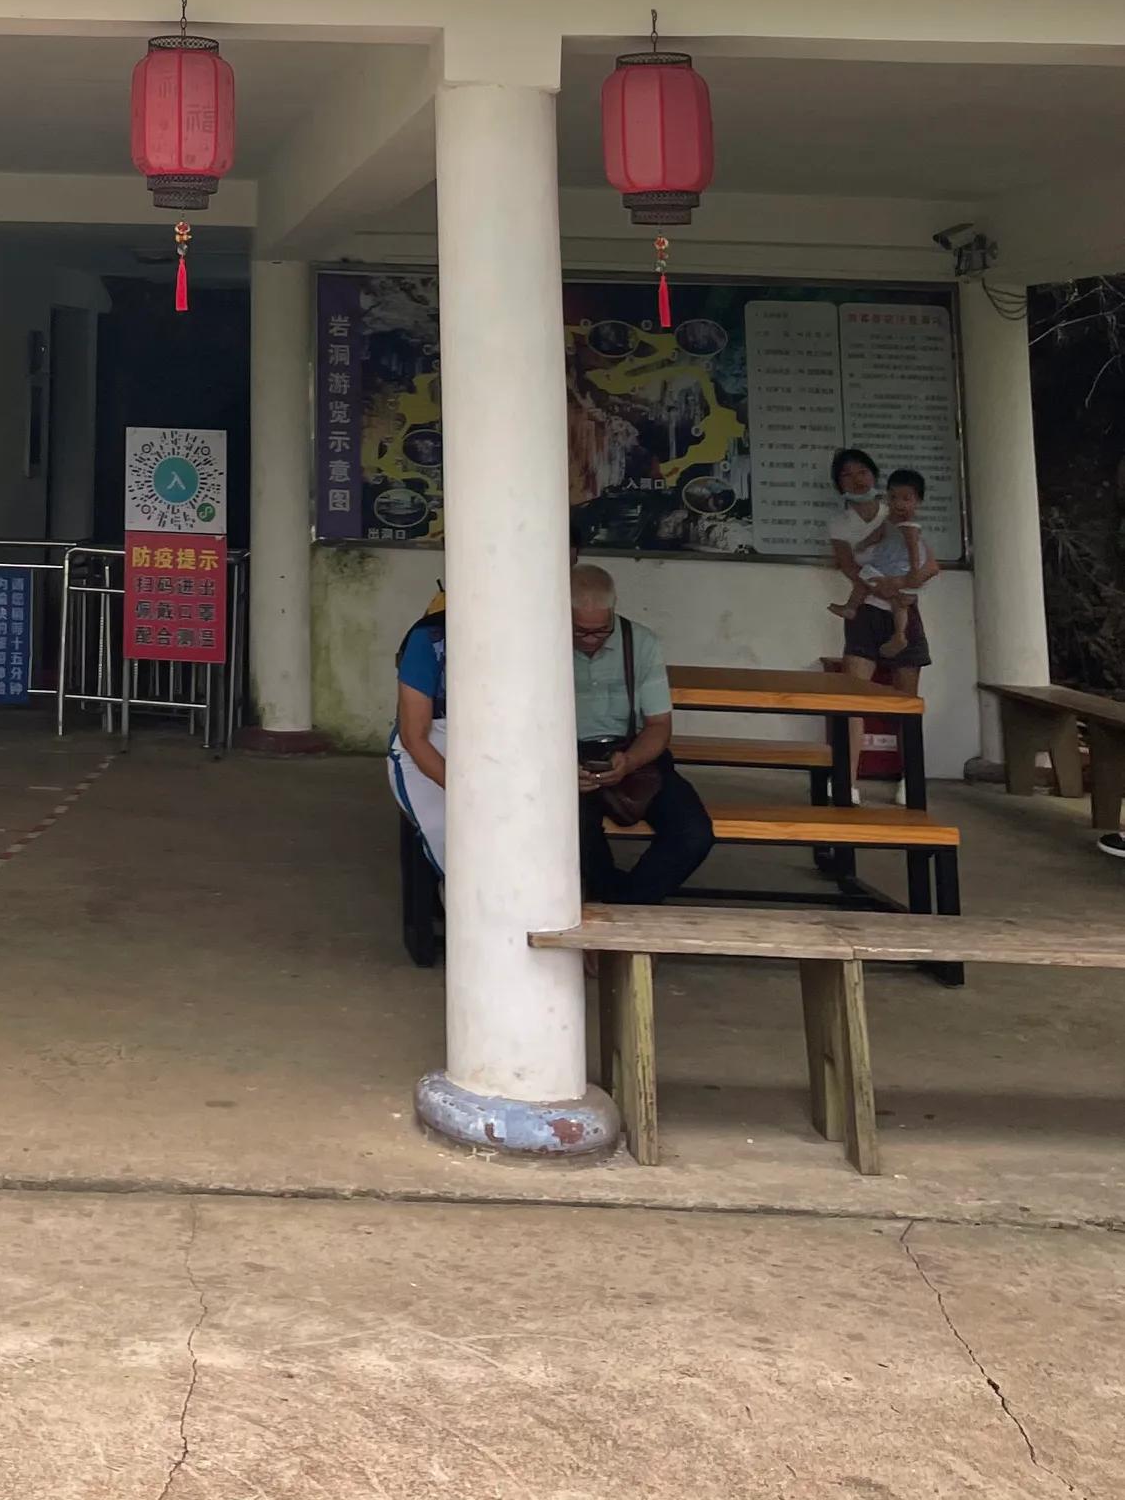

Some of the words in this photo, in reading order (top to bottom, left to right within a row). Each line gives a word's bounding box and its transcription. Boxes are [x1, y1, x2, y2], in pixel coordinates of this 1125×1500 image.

[328, 314, 351, 512] 岩洞游览示意图
[626, 476, 665, 491] 入洞口
[132, 546, 219, 571] 防疫提示
[137, 576, 215, 597] 扫码进出
